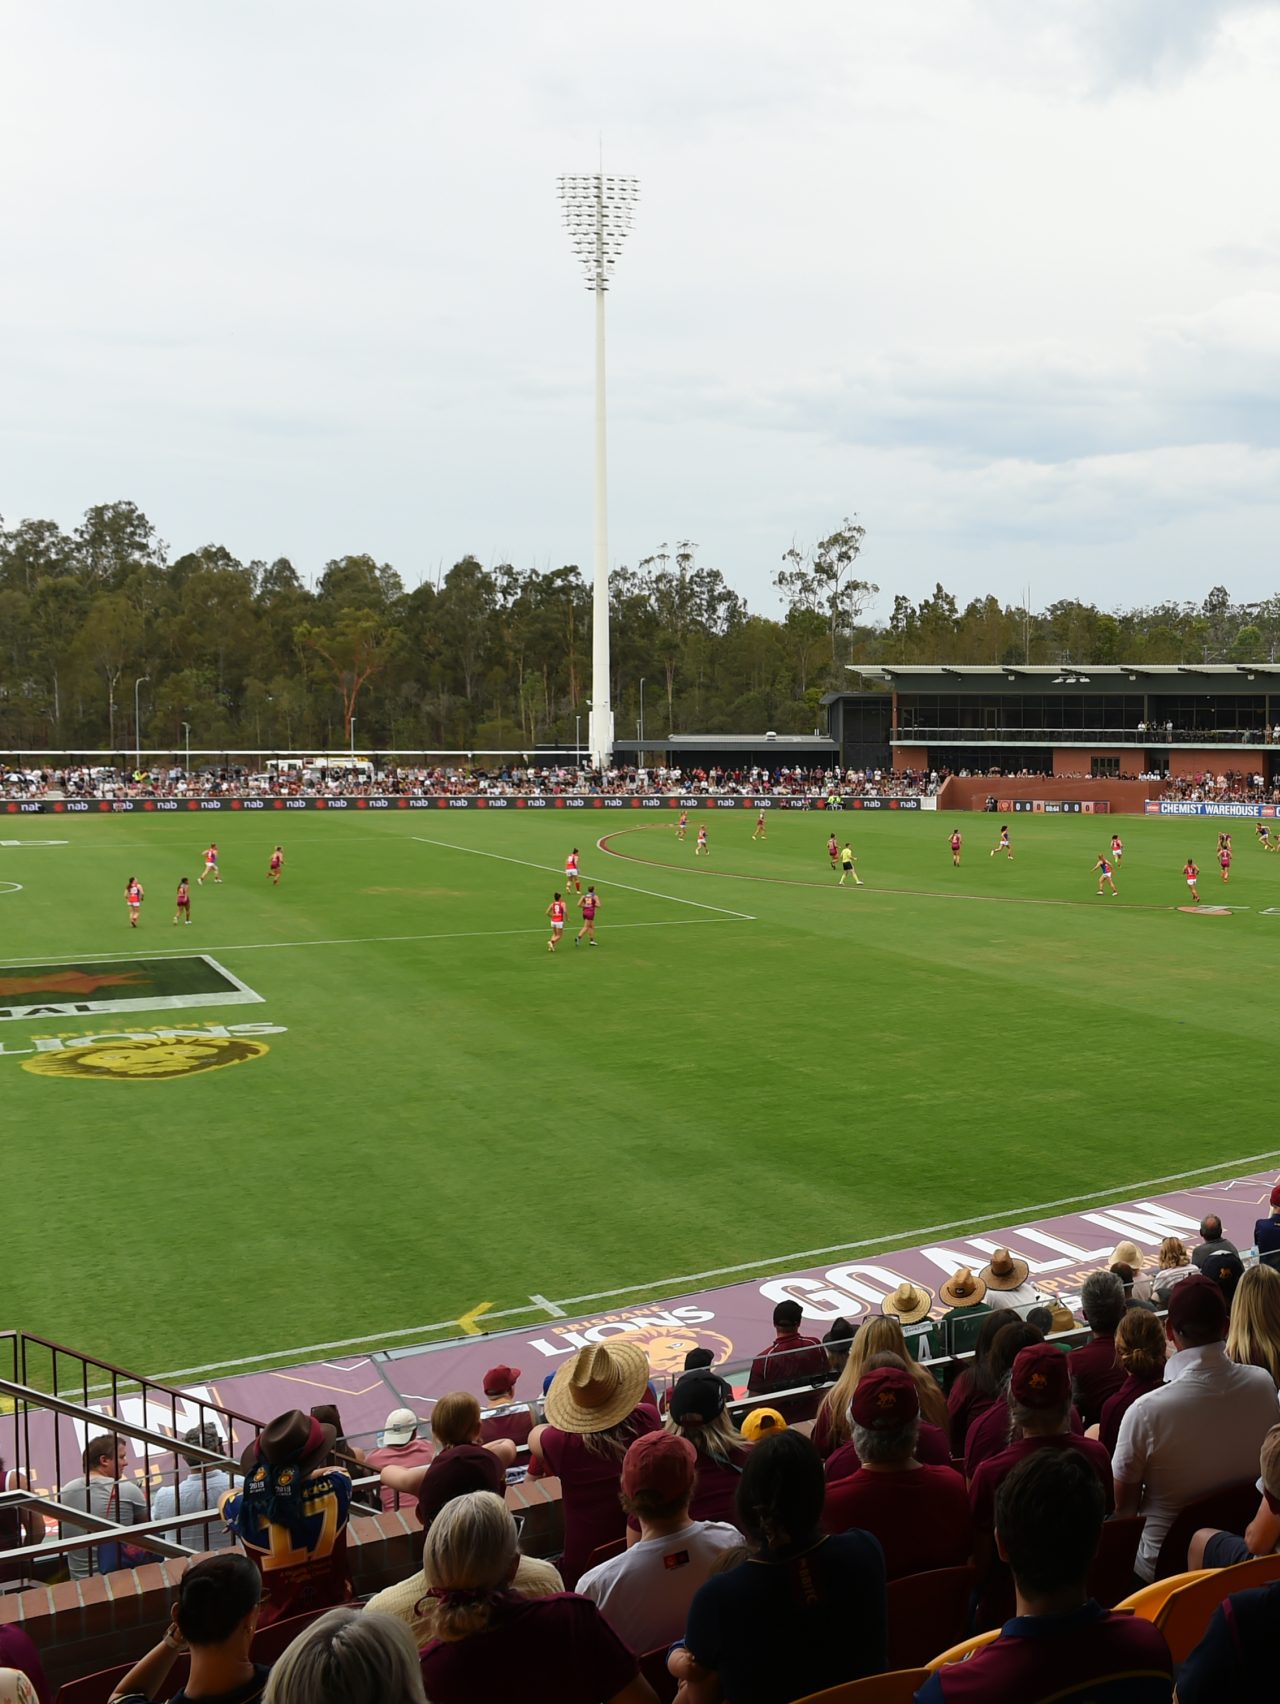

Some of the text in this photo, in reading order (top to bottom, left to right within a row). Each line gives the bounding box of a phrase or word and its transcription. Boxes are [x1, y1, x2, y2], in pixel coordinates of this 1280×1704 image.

[67, 802, 88, 810] nab
[157, 801, 177, 809] nab
[201, 800, 220, 808] nab
[244, 800, 263, 808] nab
[287, 799, 306, 807] nab
[328, 799, 347, 807] nab
[369, 799, 388, 807] nab
[528, 798, 545, 806] nab
[567, 798, 584, 806] nab
[605, 798, 622, 806] nab
[643, 798, 660, 806] nab
[900, 800, 917, 808] nab
[1161, 803, 1202, 814] CHEMIST
[1205, 804, 1259, 816] WAREHOUSE
[758, 1264, 922, 1321] GO
[1079, 1201, 1203, 1246] IN
[528, 1305, 715, 1357] LIONS
[551, 1305, 666, 1336] BRISBANE
[257, 1492, 339, 1572] 17
